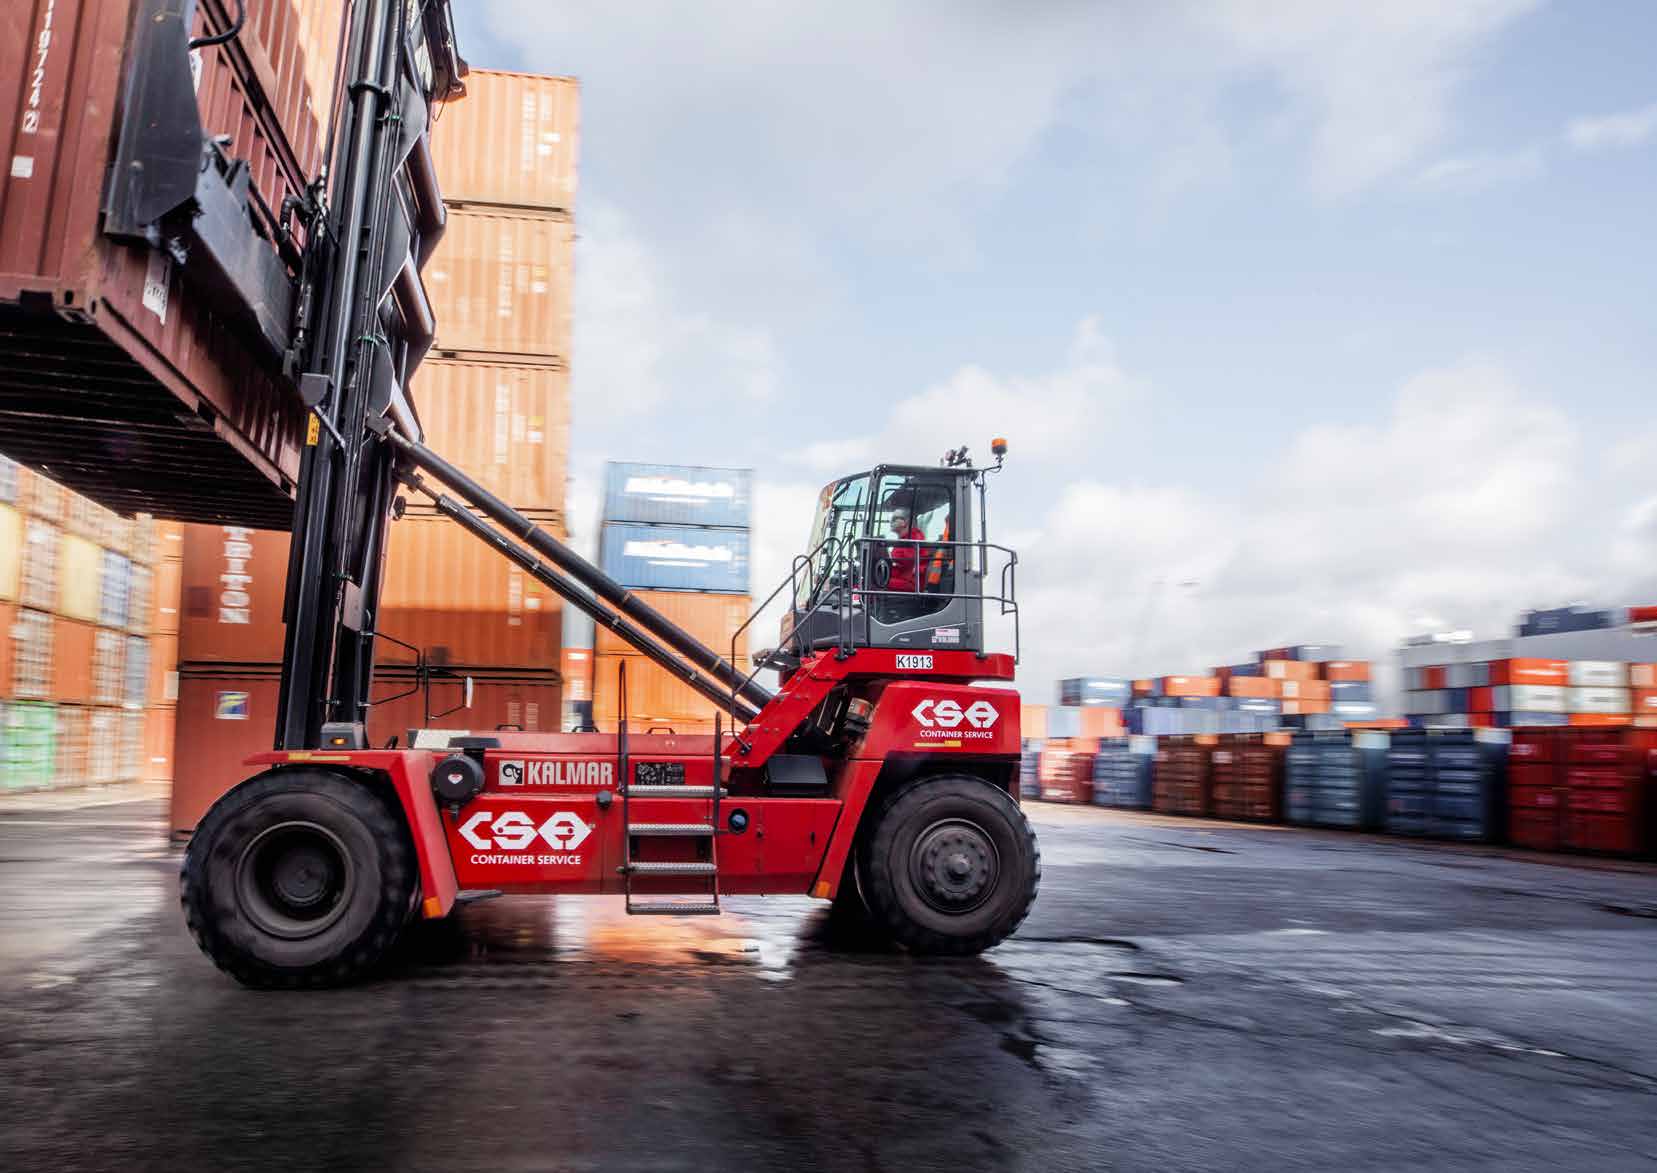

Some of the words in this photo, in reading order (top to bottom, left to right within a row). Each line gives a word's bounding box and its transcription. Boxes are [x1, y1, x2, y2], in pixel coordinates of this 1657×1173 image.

[897, 655, 932, 668] K1913
[911, 699, 999, 728] CSA
[920, 730, 962, 738] CONTAINER
[964, 731, 993, 739] SERVICE
[527, 761, 613, 785] KALMAR
[458, 811, 592, 850] CSA
[470, 854, 535, 865] CONTAINER
[537, 855, 581, 865] SERVICE
